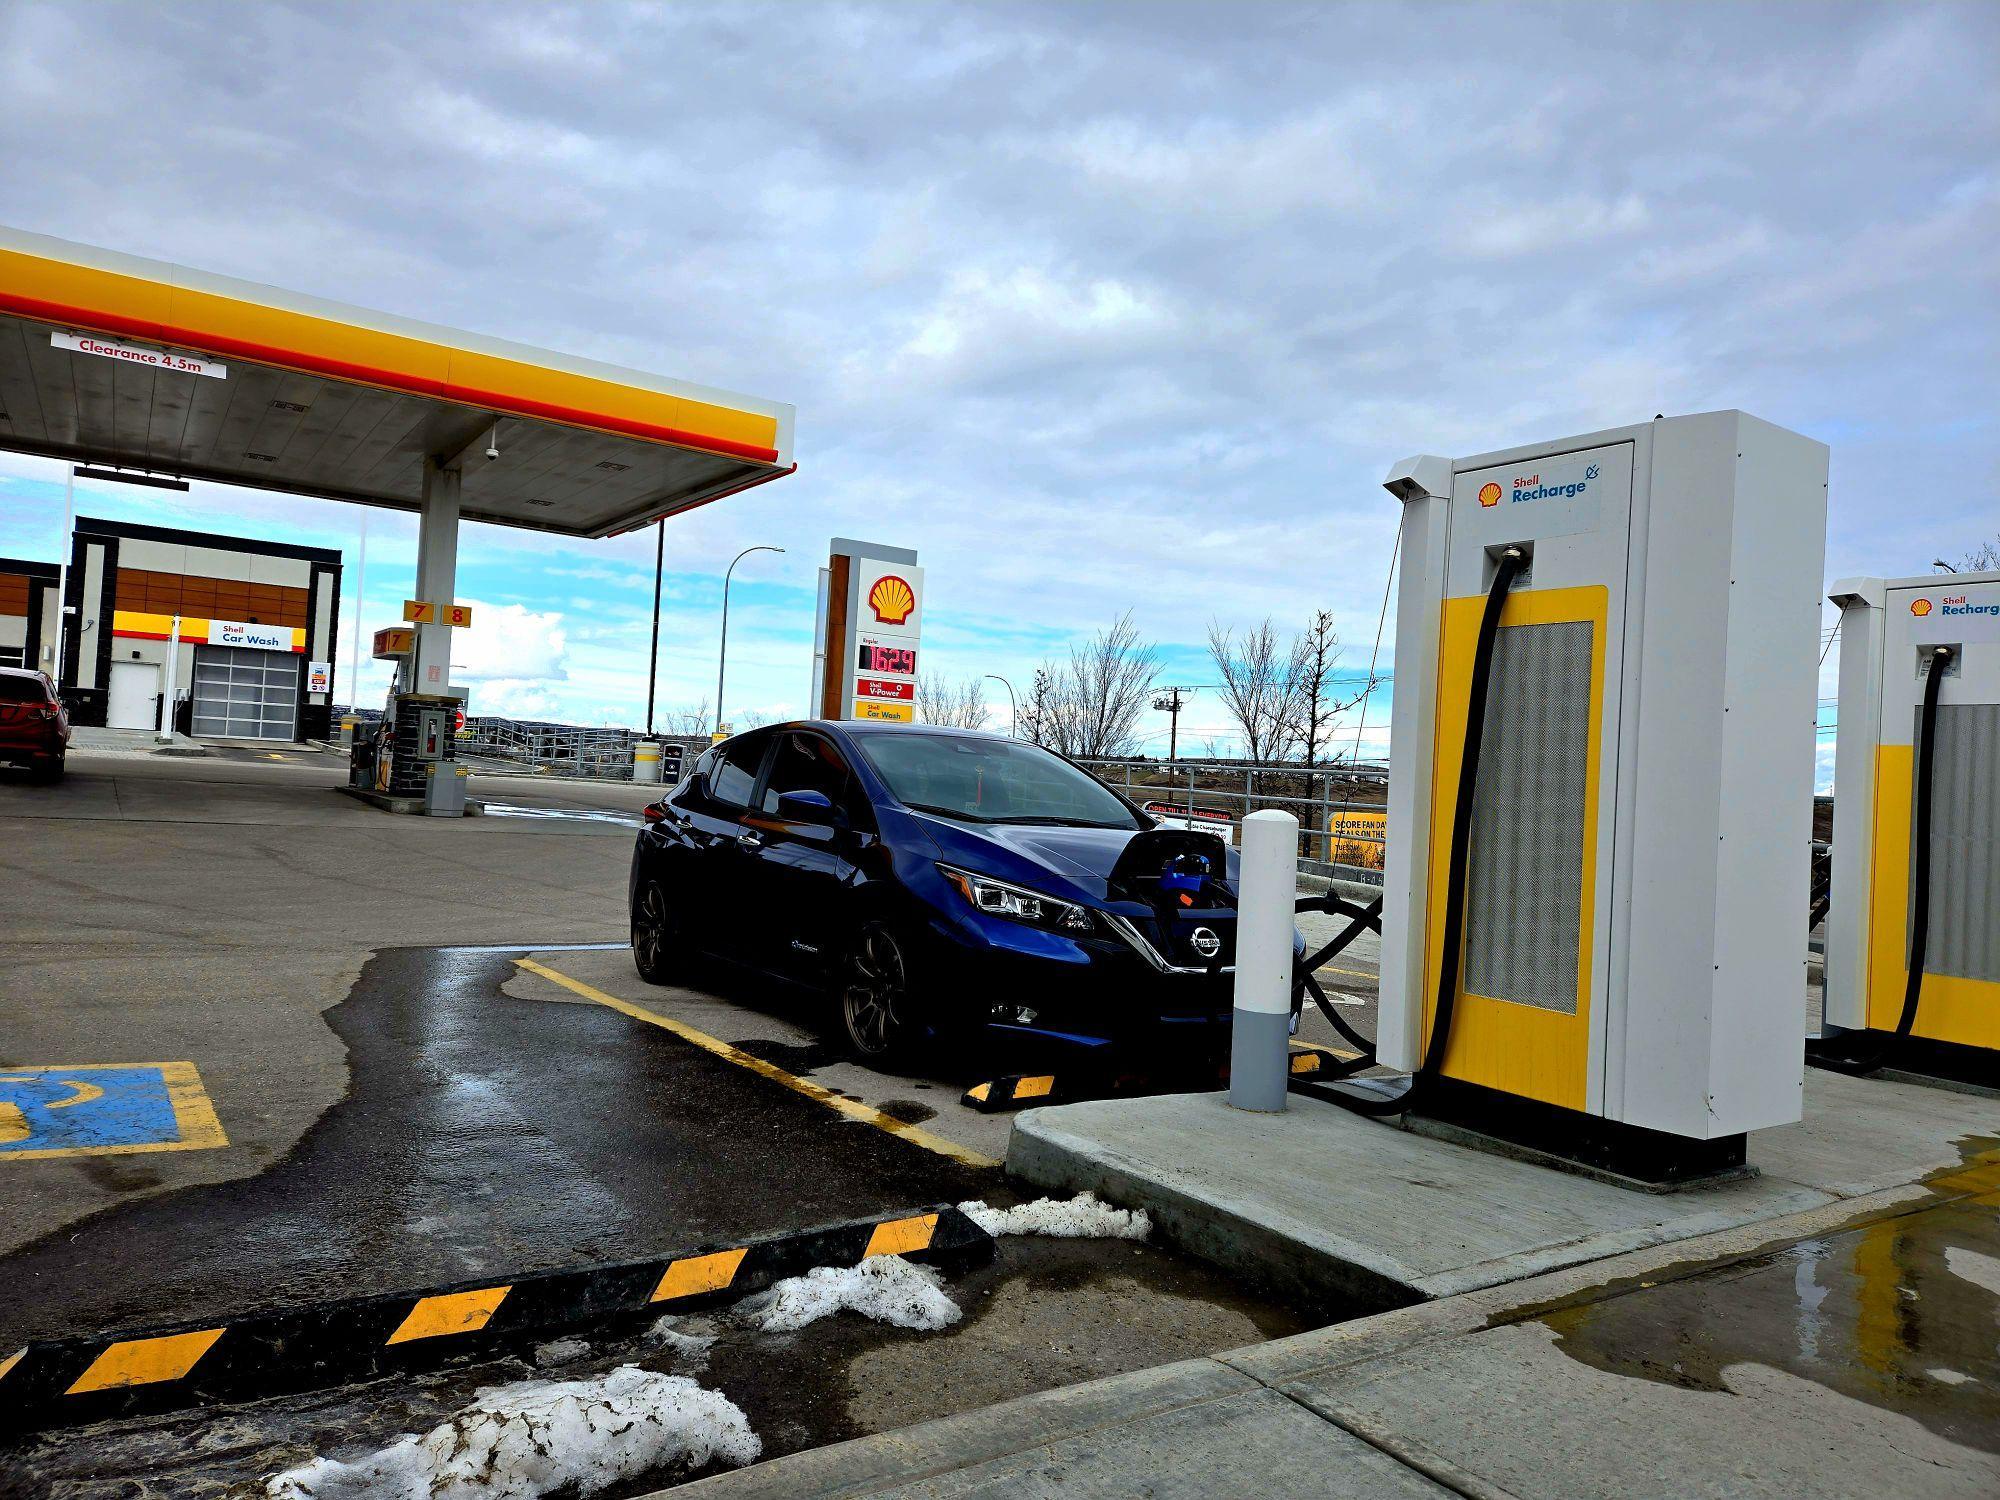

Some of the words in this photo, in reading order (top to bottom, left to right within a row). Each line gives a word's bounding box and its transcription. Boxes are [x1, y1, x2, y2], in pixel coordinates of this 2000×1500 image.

[79, 340, 157, 363] Clearance
[161, 355, 202, 372] 4.5m
[1513, 474, 1540, 488] Shell
[1512, 482, 1586, 503] Recharge
[1942, 596, 1966, 604] Shell
[413, 604, 427, 618] 7
[451, 608, 463, 623] 8
[222, 625, 244, 634] Shell
[222, 633, 243, 643] Car
[246, 635, 279, 646] Wash
[392, 634, 401, 648] 7
[869, 681, 882, 689] Shell
[869, 687, 900, 697] V-Power
[867, 710, 880, 718] Car
[881, 711, 901, 720] Wash
[1148, 805, 1167, 814] OPEN
[1335, 820, 1361, 829] SCORE
[1362, 820, 1375, 829] FAN
[1376, 821, 1387, 829] DA
